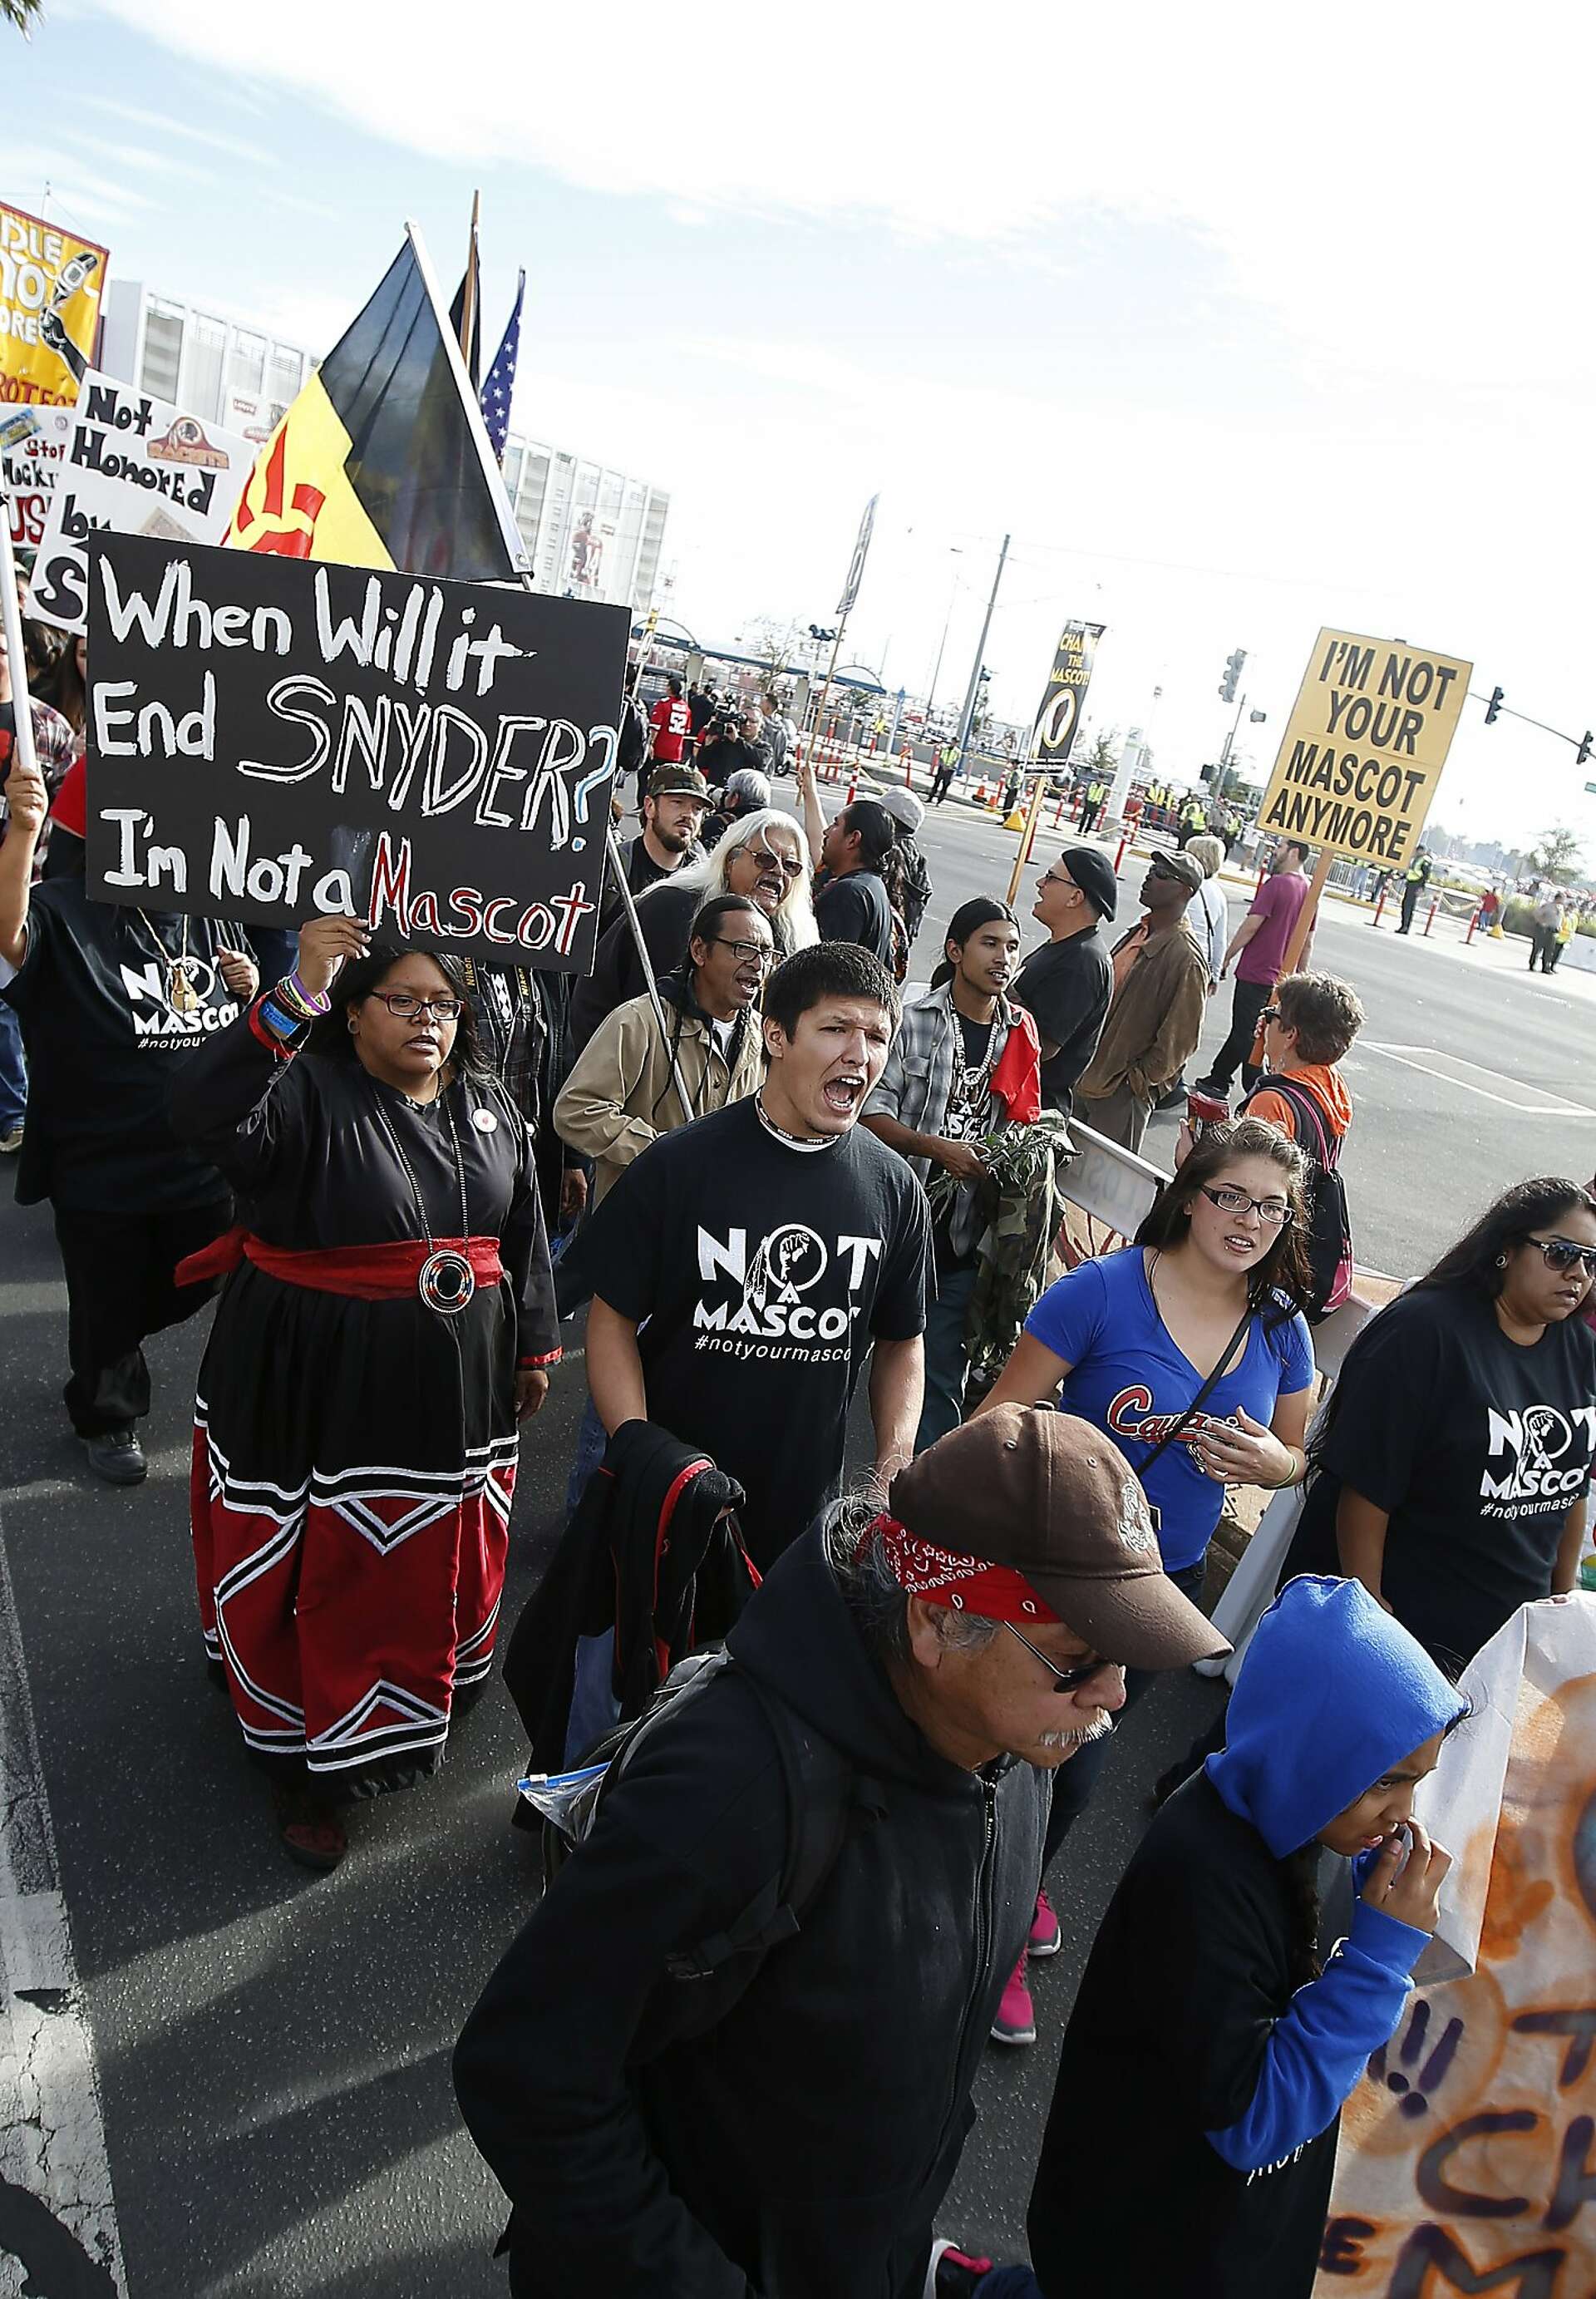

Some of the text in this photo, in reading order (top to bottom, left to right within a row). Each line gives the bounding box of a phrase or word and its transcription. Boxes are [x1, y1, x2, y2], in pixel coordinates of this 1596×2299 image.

[85, 386, 152, 436] Not
[99, 553, 539, 696] When Will it
[1319, 640, 1457, 710] I'M NOT
[668, 711, 687, 735] 52
[1326, 690, 1424, 755] YOUR
[93, 670, 618, 851] End SNYDER?
[1285, 740, 1426, 813] MASCOT
[1265, 788, 1411, 861] ANYMORE
[99, 808, 594, 956] I'm Not a Mascot
[697, 1223, 882, 1291] NOT
[692, 1298, 861, 1341] MASCO
[776, 1280, 801, 1304] A
[1480, 1464, 1589, 1500] MASCO
[1533, 1450, 1553, 1470] A
